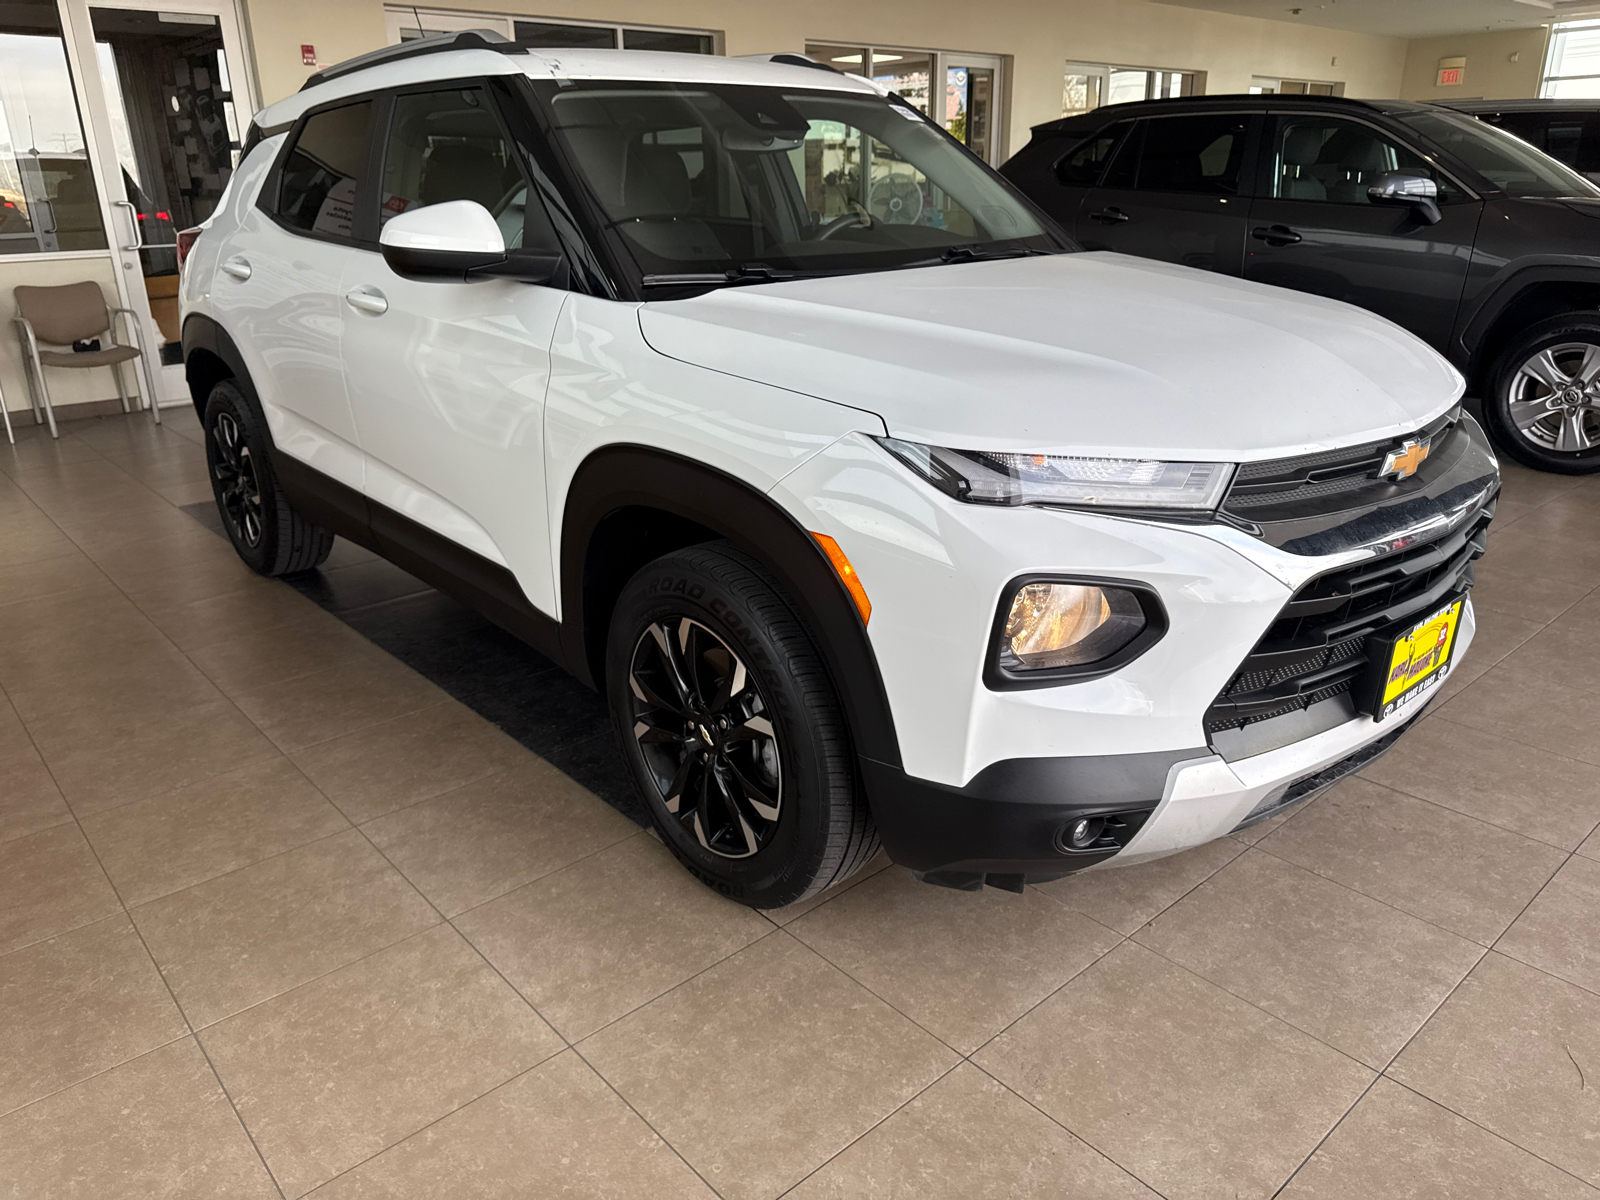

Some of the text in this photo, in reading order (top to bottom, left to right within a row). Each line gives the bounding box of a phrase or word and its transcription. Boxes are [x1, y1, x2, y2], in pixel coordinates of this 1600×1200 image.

[1441, 69, 1460, 84] EXIT
[1439, 627, 1447, 641] 32
[648, 576, 706, 601] ROAD
[708, 597, 797, 732] CONTROL
[1396, 696, 1405, 709] WE
[1418, 682, 1425, 693] IT
[1424, 674, 1437, 689] EASY
